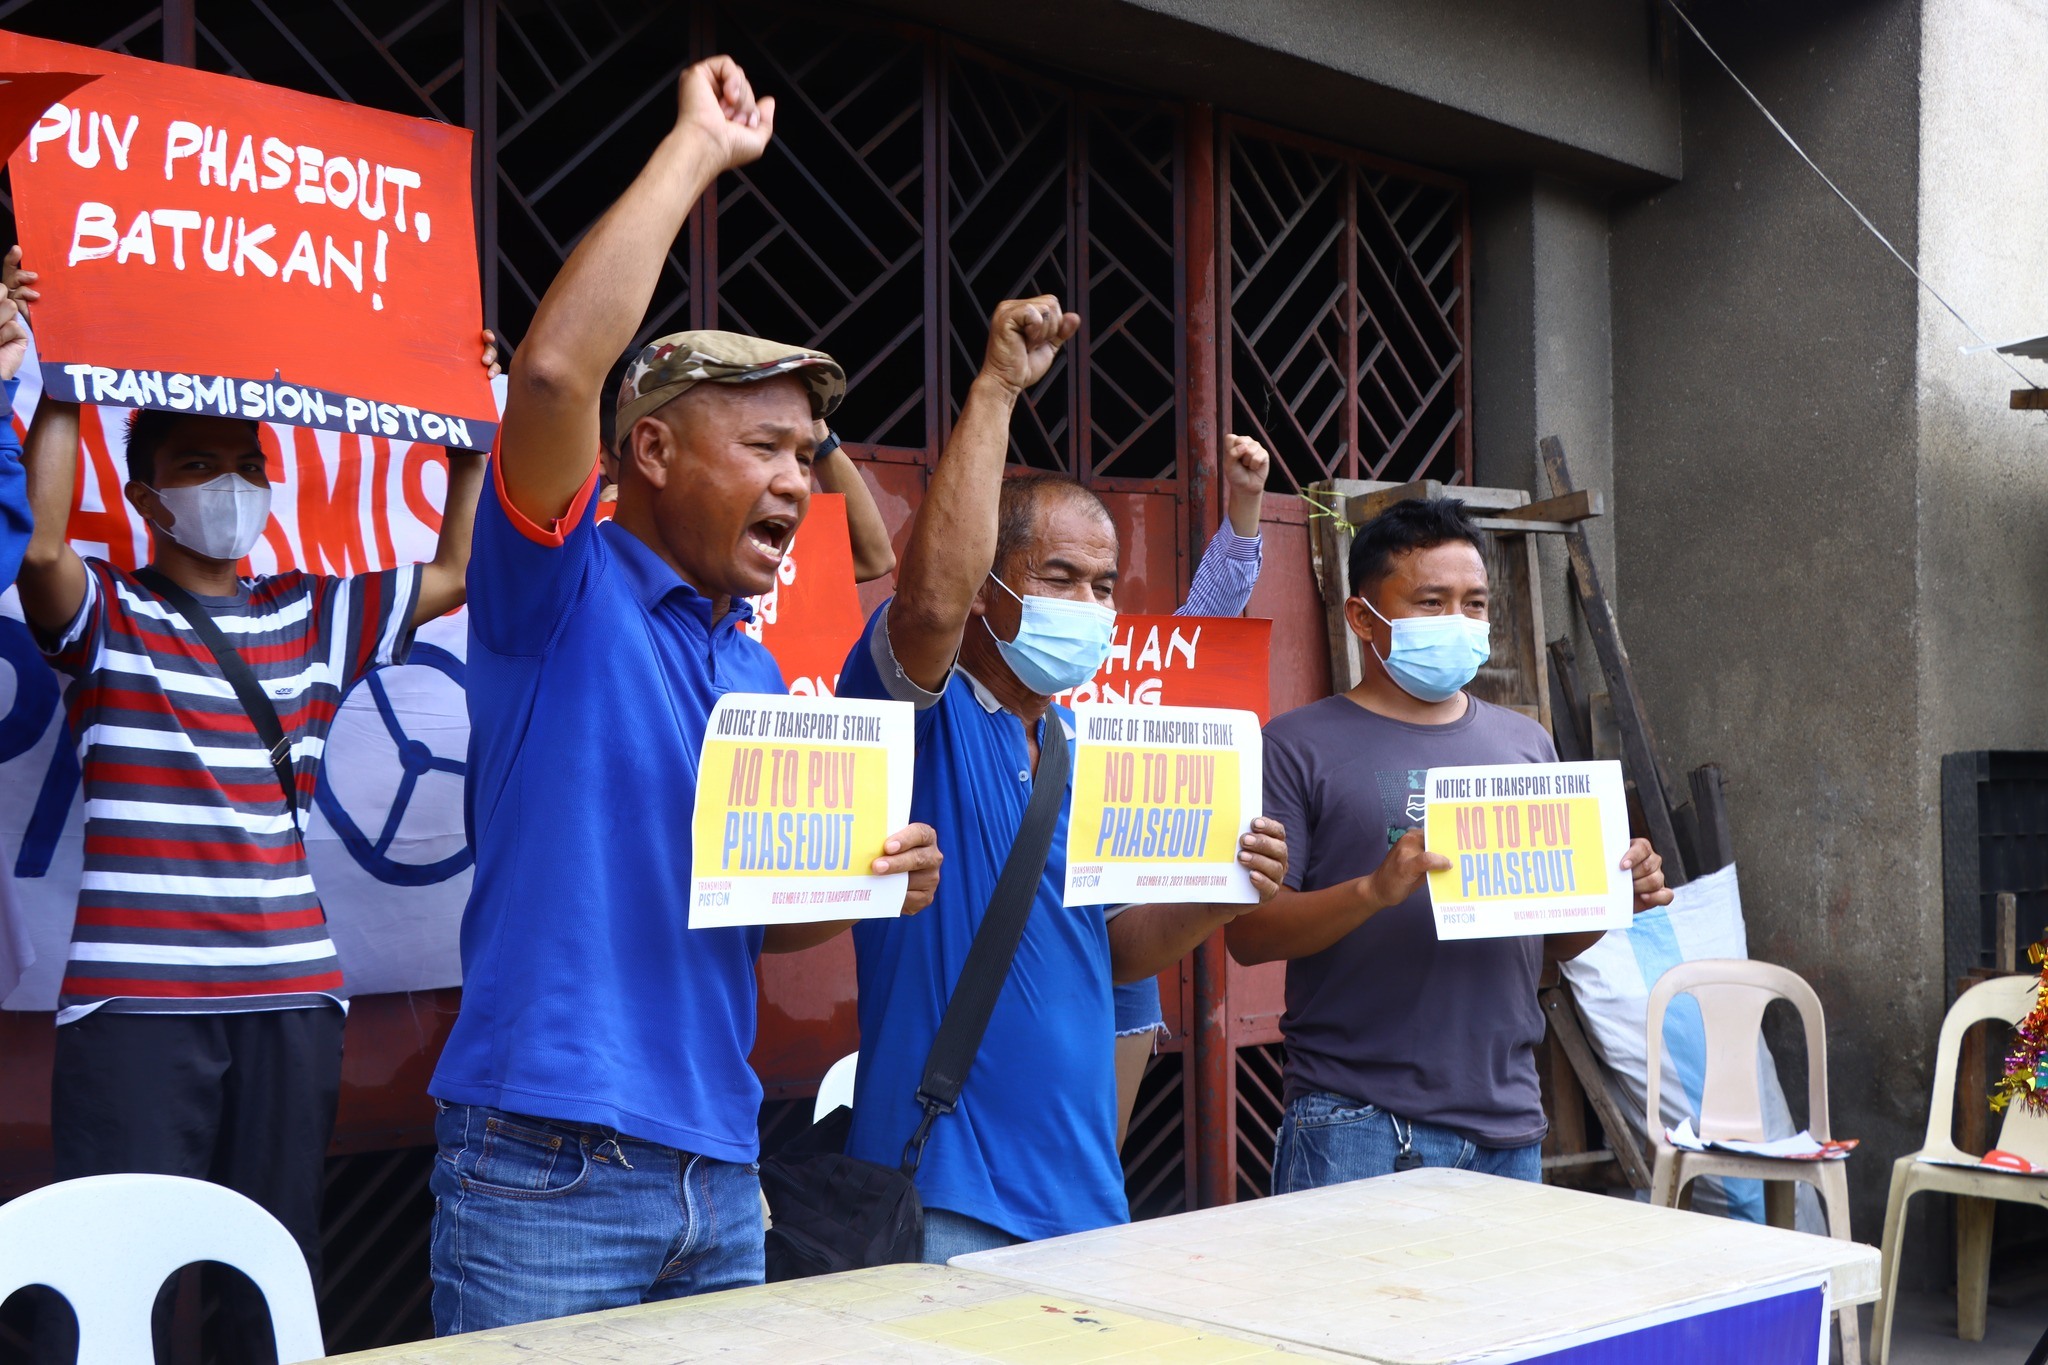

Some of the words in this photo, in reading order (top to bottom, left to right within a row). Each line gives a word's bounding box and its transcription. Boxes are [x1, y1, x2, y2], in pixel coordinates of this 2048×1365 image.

[30, 103, 139, 170] PUV
[164, 120, 430, 243] PHASEOUT,
[68, 202, 388, 310] BATUKAN!
[64, 364, 472, 448] TRANSMISION-PISTON
[1098, 625, 1202, 674] HAN
[717, 709, 756, 736] NOTICE
[758, 710, 772, 737] OF
[774, 711, 839, 740] TRANSPORT
[843, 715, 881, 742] STRIKE
[1088, 717, 1123, 741] NOTICE
[1127, 719, 1139, 742] OF
[1143, 720, 1199, 744] TRANSPORT
[1203, 723, 1233, 746] STRIKE
[727, 748, 763, 807] NO
[770, 749, 799, 808] TO
[808, 750, 855, 809] PUV
[1104, 751, 1134, 803] NO
[1143, 753, 1167, 804] TO
[1174, 754, 1214, 805] PUV
[1436, 779, 1471, 799] NOTICE
[1475, 778, 1487, 798] OF
[1491, 776, 1551, 797] TRANSPORT
[1555, 774, 1591, 794] STRIKE
[722, 811, 854, 870] PHASEOUT
[1095, 807, 1213, 857] PHASEOUT
[1456, 806, 1487, 850] NO
[1493, 805, 1521, 849] TO
[1528, 803, 1571, 847] PUV
[698, 881, 732, 891] TRANSMISION
[1071, 866, 1103, 875] TRANSMISION
[1136, 875, 1162, 887] DECEMBER
[1169, 876, 1183, 886] 2023
[1183, 876, 1211, 886] TRANSPORT
[1211, 876, 1227, 886] STRIKE
[1460, 849, 1576, 897] PHASEOUT
[772, 891, 800, 904] DECEMBER
[809, 891, 825, 904] 2023
[825, 890, 853, 903] TRANSPORT
[853, 889, 872, 901] STRIKE
[1514, 910, 1539, 920] DECEMBER
